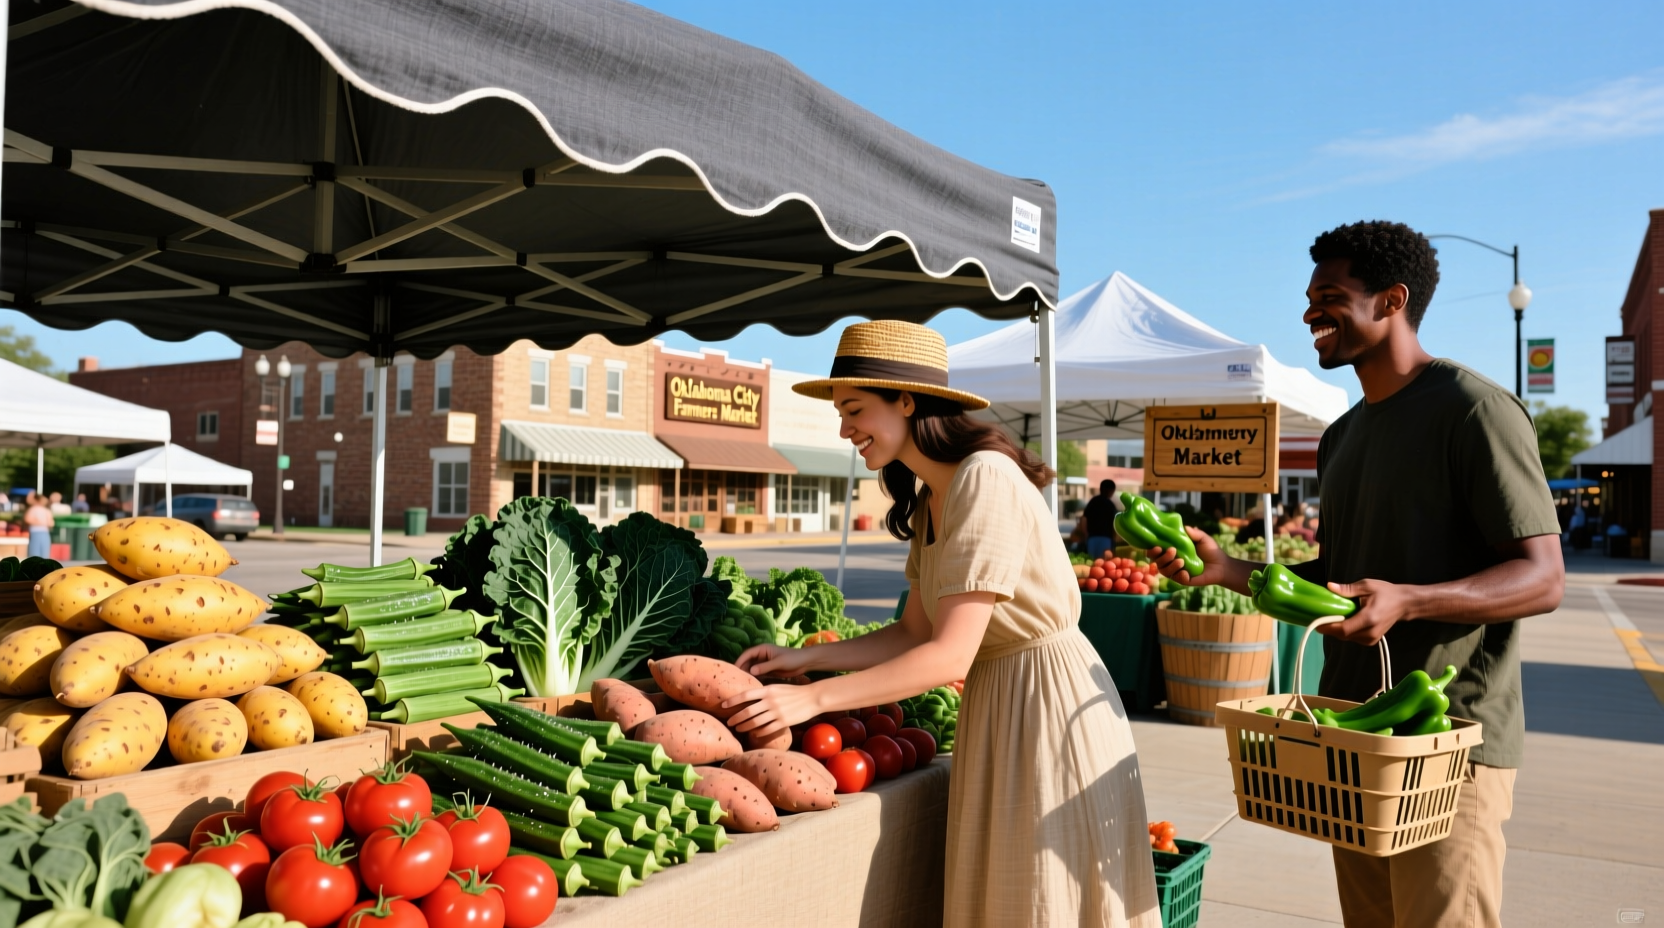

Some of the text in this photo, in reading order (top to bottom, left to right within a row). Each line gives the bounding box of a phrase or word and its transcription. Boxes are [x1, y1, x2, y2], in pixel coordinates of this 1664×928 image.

[671, 377, 760, 411] Oklahoma City
[1172, 447, 1242, 466] Market
